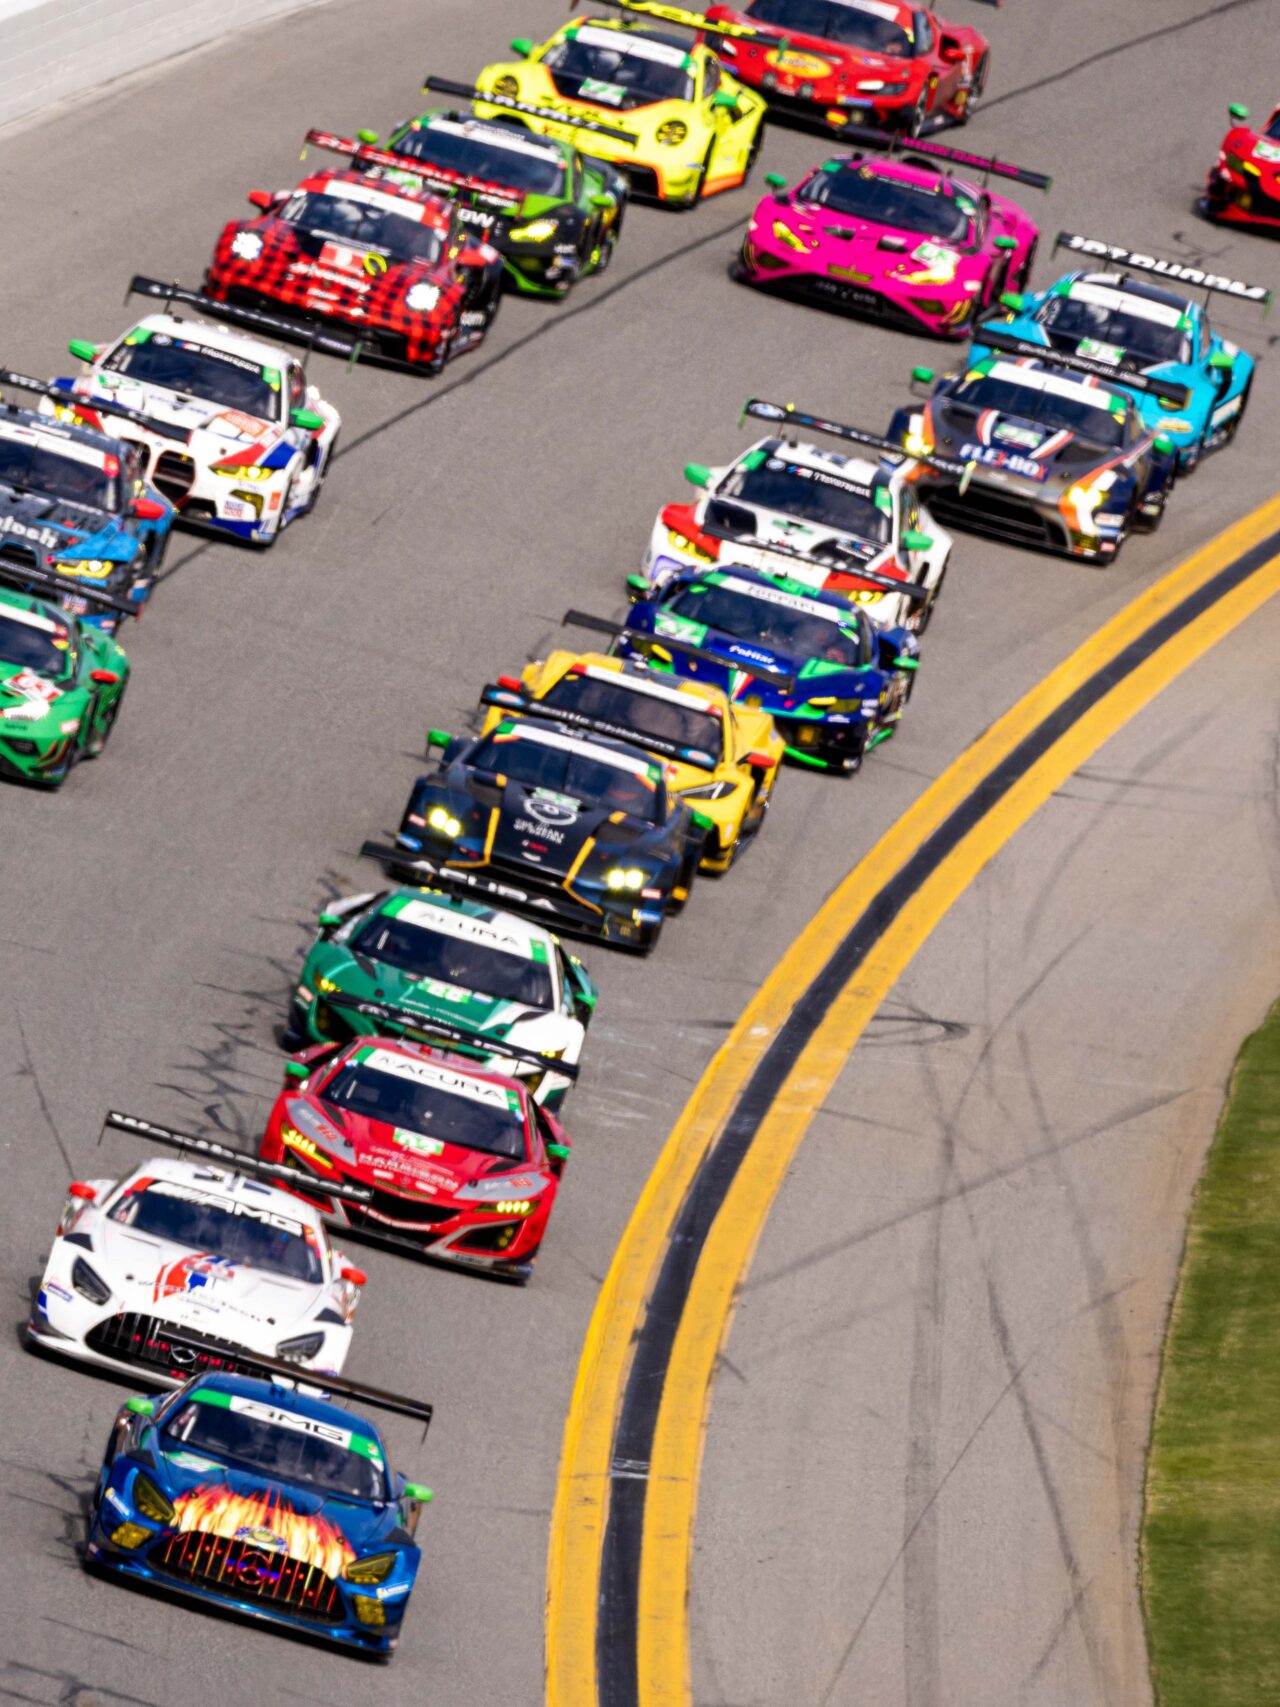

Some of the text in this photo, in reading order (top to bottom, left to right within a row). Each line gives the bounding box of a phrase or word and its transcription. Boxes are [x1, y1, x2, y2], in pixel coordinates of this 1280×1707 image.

[409, 859, 559, 913] ACURA
[395, 1065, 503, 1101] ACURA
[204, 1194, 302, 1238] AMG
[238, 1402, 344, 1442] AMG
